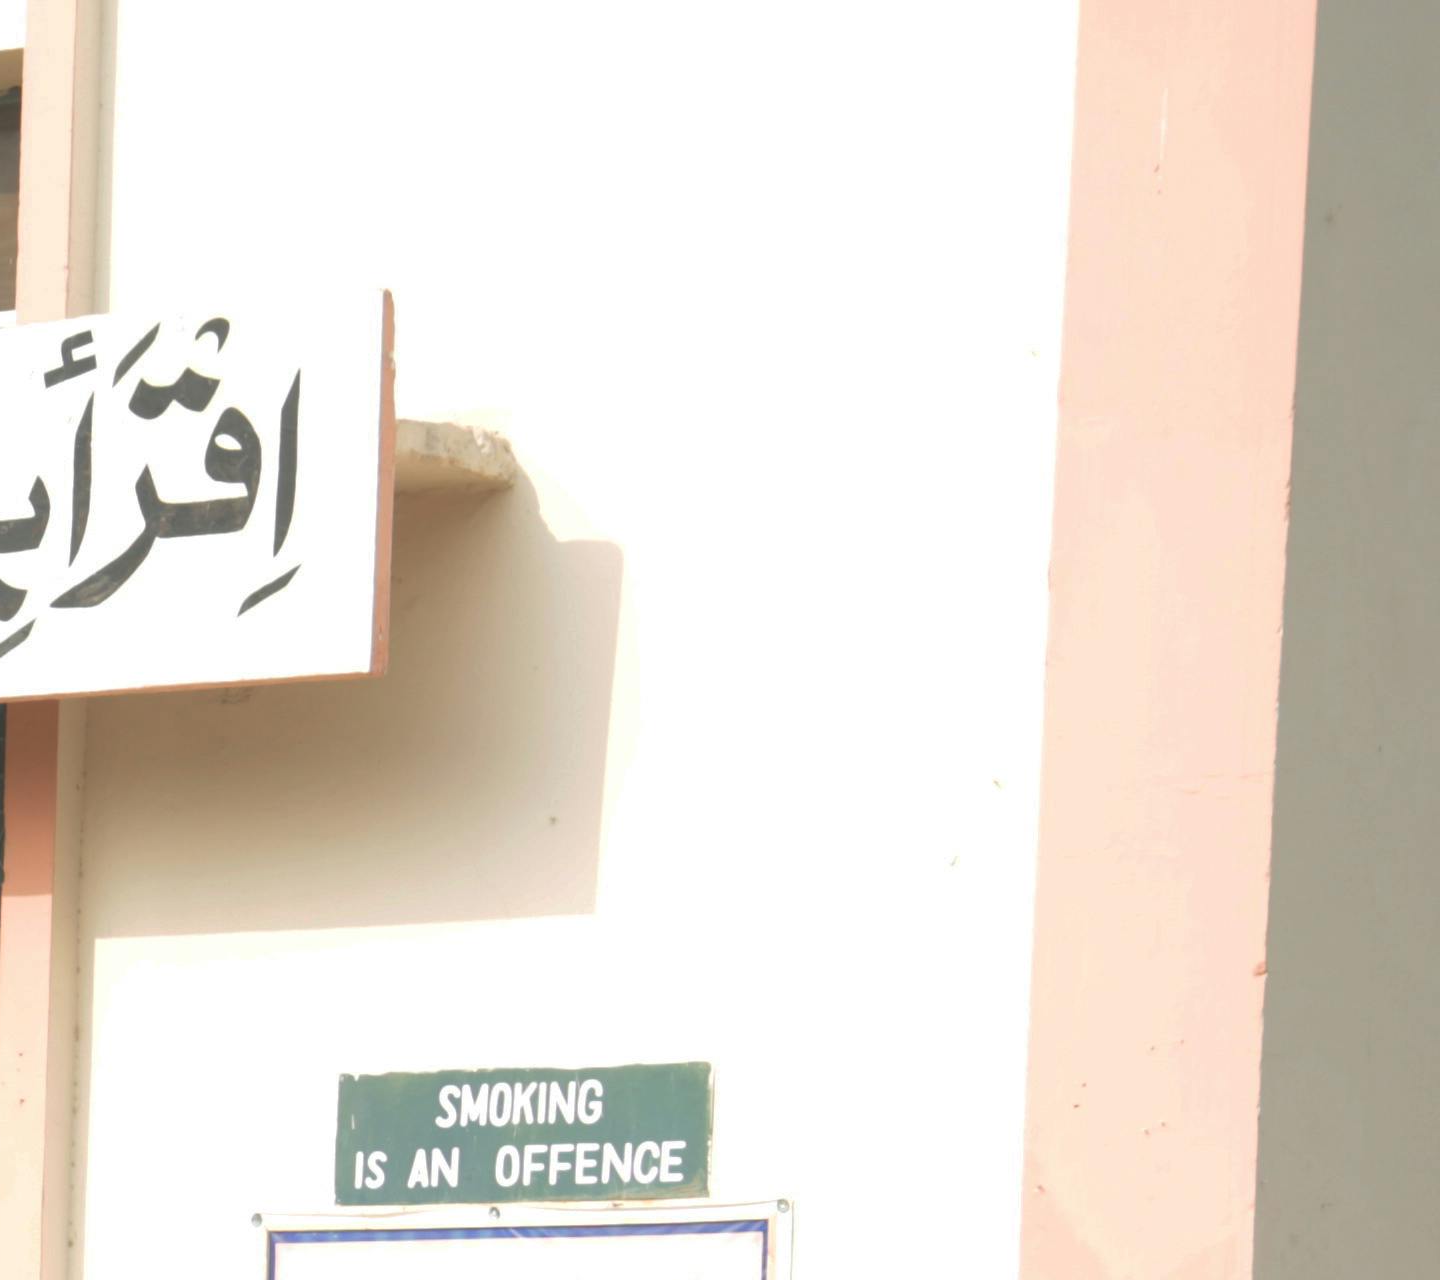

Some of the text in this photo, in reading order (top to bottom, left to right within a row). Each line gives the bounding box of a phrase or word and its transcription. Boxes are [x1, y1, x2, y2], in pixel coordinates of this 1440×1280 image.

[434, 1078, 605, 1130] SMOKING
[354, 1140, 687, 1190] IS AN OFFENCE
